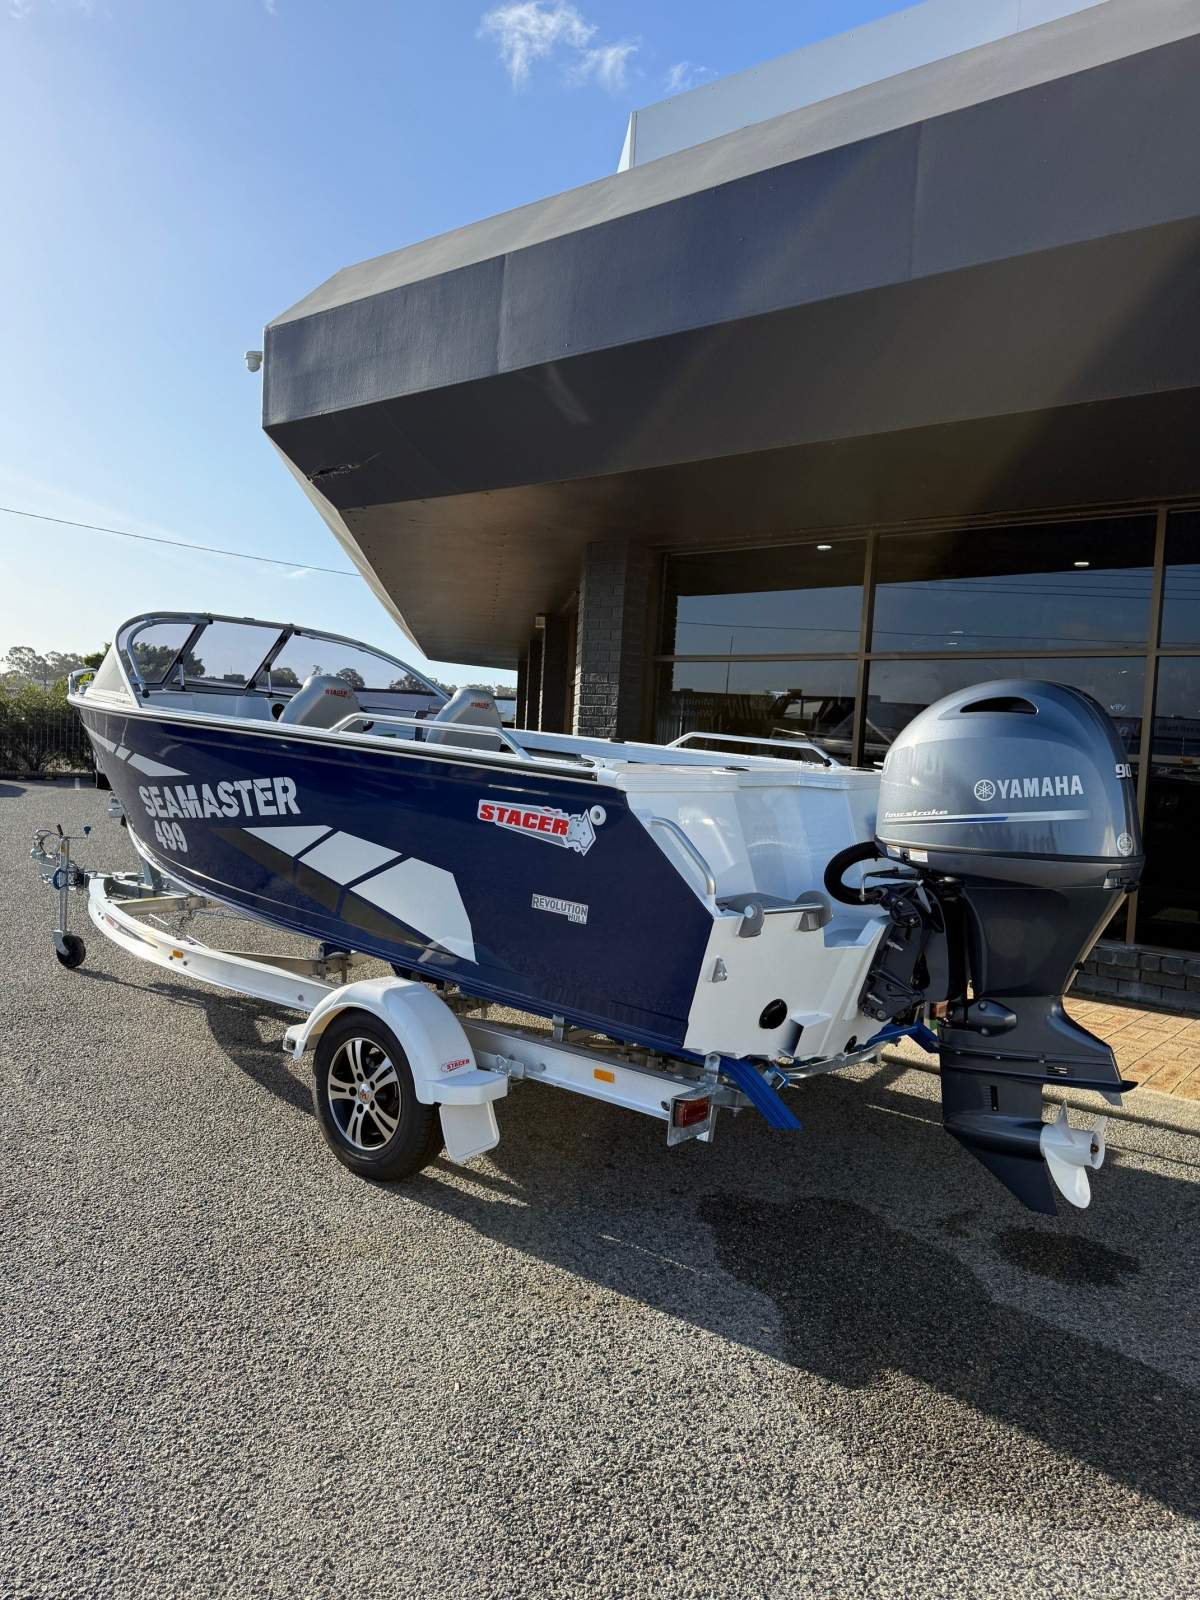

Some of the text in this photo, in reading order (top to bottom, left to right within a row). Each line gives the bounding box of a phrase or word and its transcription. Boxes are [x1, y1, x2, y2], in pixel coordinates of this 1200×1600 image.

[1115, 763, 1132, 778] 90
[138, 776, 301, 819] SEAMASTER
[997, 775, 1084, 799] YAMAHA
[479, 804, 570, 836] STACER
[154, 820, 188, 853] 499
[532, 896, 588, 916] REVOLUTION
